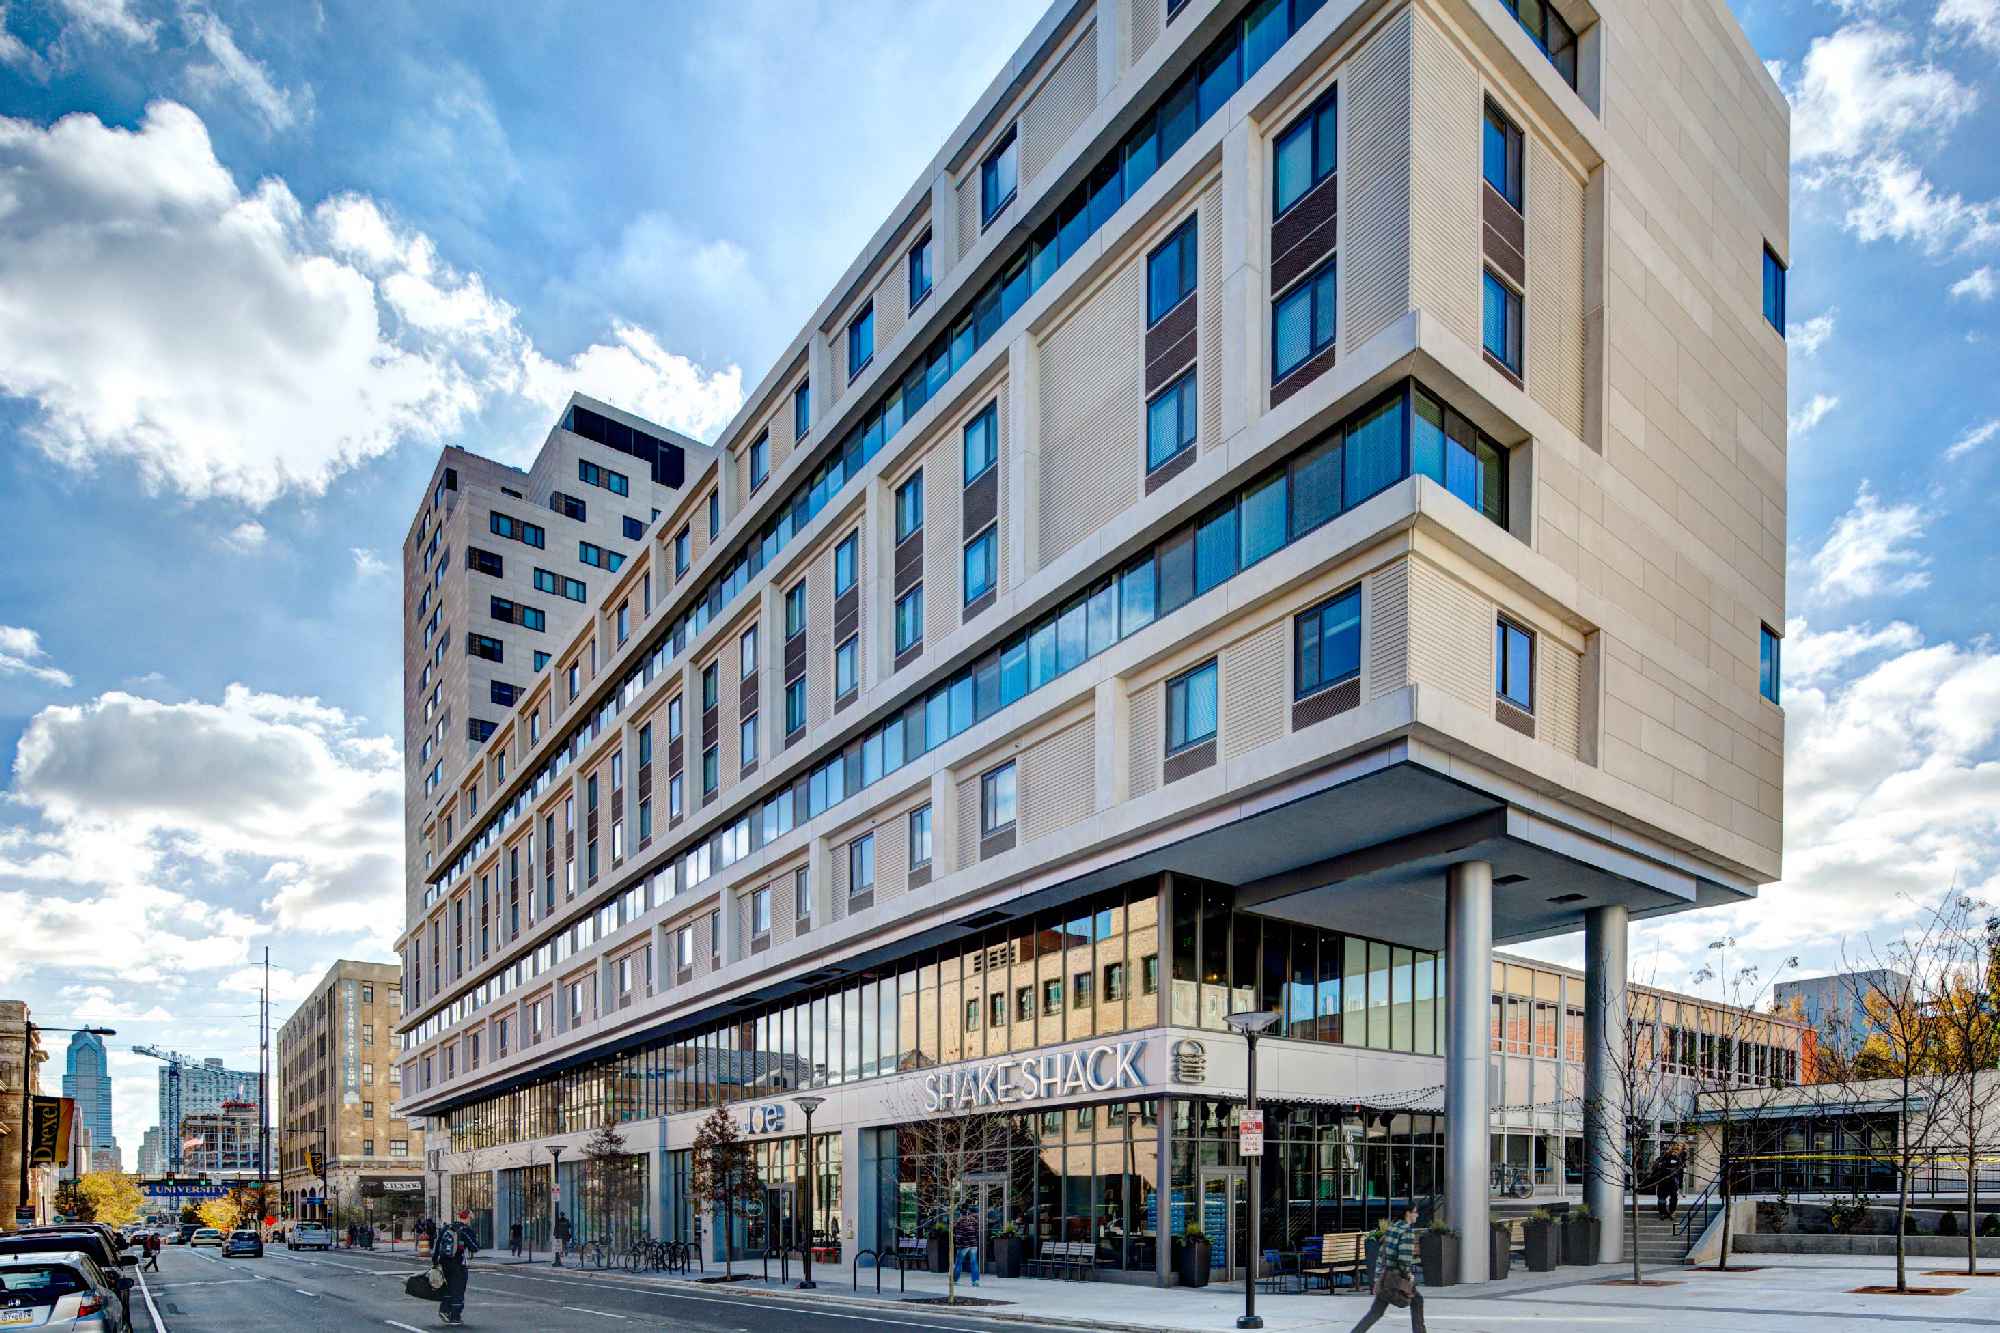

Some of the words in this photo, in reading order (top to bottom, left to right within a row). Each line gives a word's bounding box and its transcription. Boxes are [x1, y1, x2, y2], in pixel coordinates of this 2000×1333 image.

[925, 1063, 1018, 1112] SHAKE
[1020, 1040, 1149, 1100] SHACK
[32, 1102, 58, 1162] Drexel
[155, 1185, 227, 1194] UNIVERSITY
